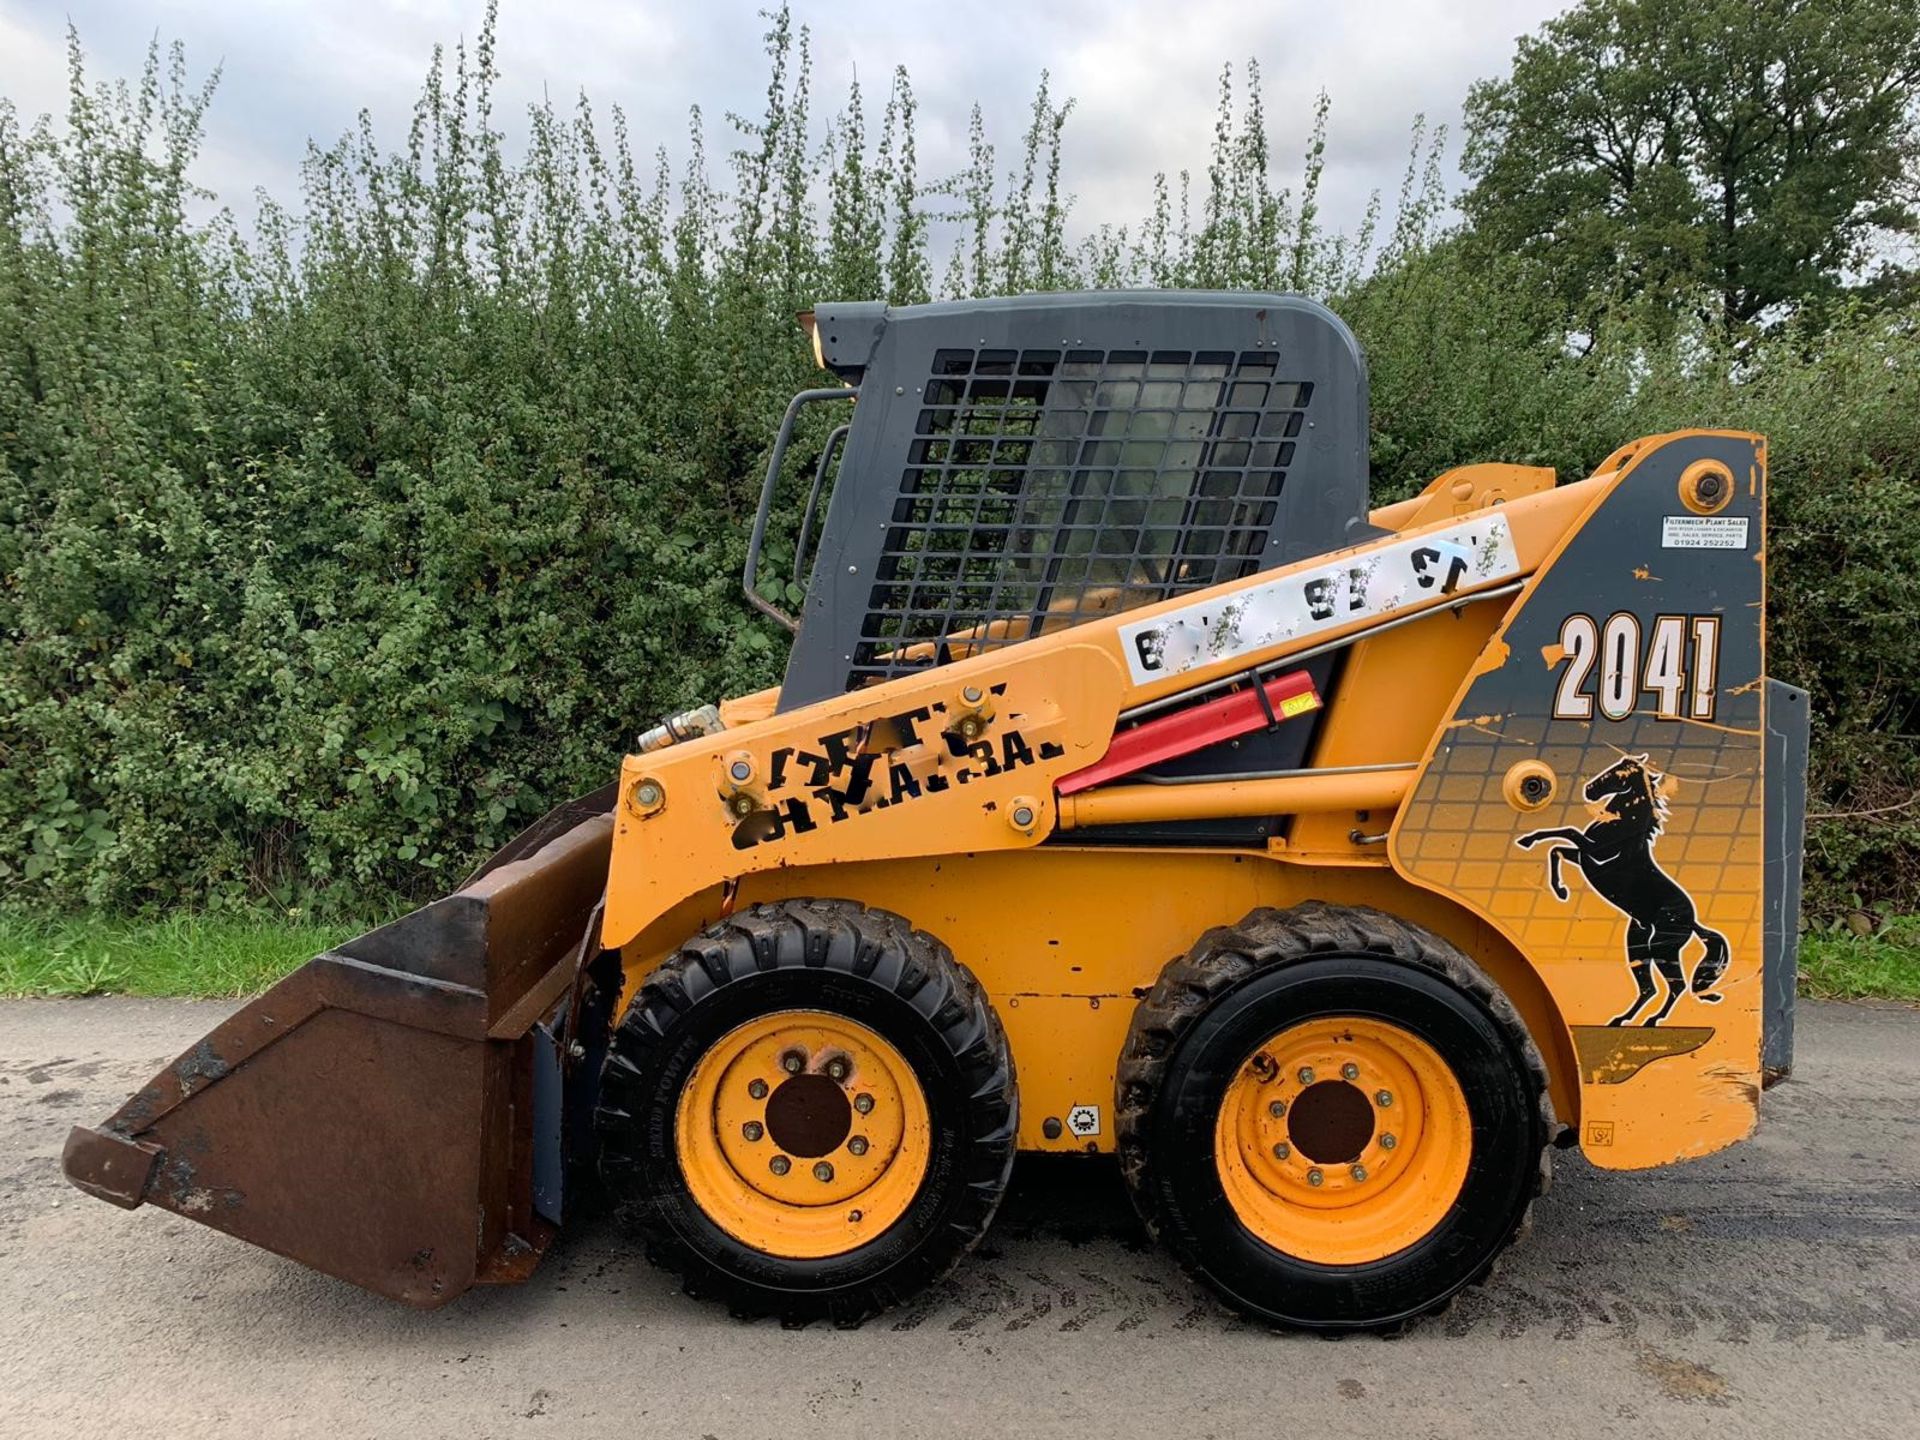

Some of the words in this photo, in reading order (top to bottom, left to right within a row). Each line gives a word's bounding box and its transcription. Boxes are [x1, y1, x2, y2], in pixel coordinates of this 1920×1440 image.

[1705, 518, 1726, 526] PLANT
[1727, 518, 1747, 526] SALES
[1703, 539, 1735, 547] 252252
[1552, 610, 1723, 722] 2041
